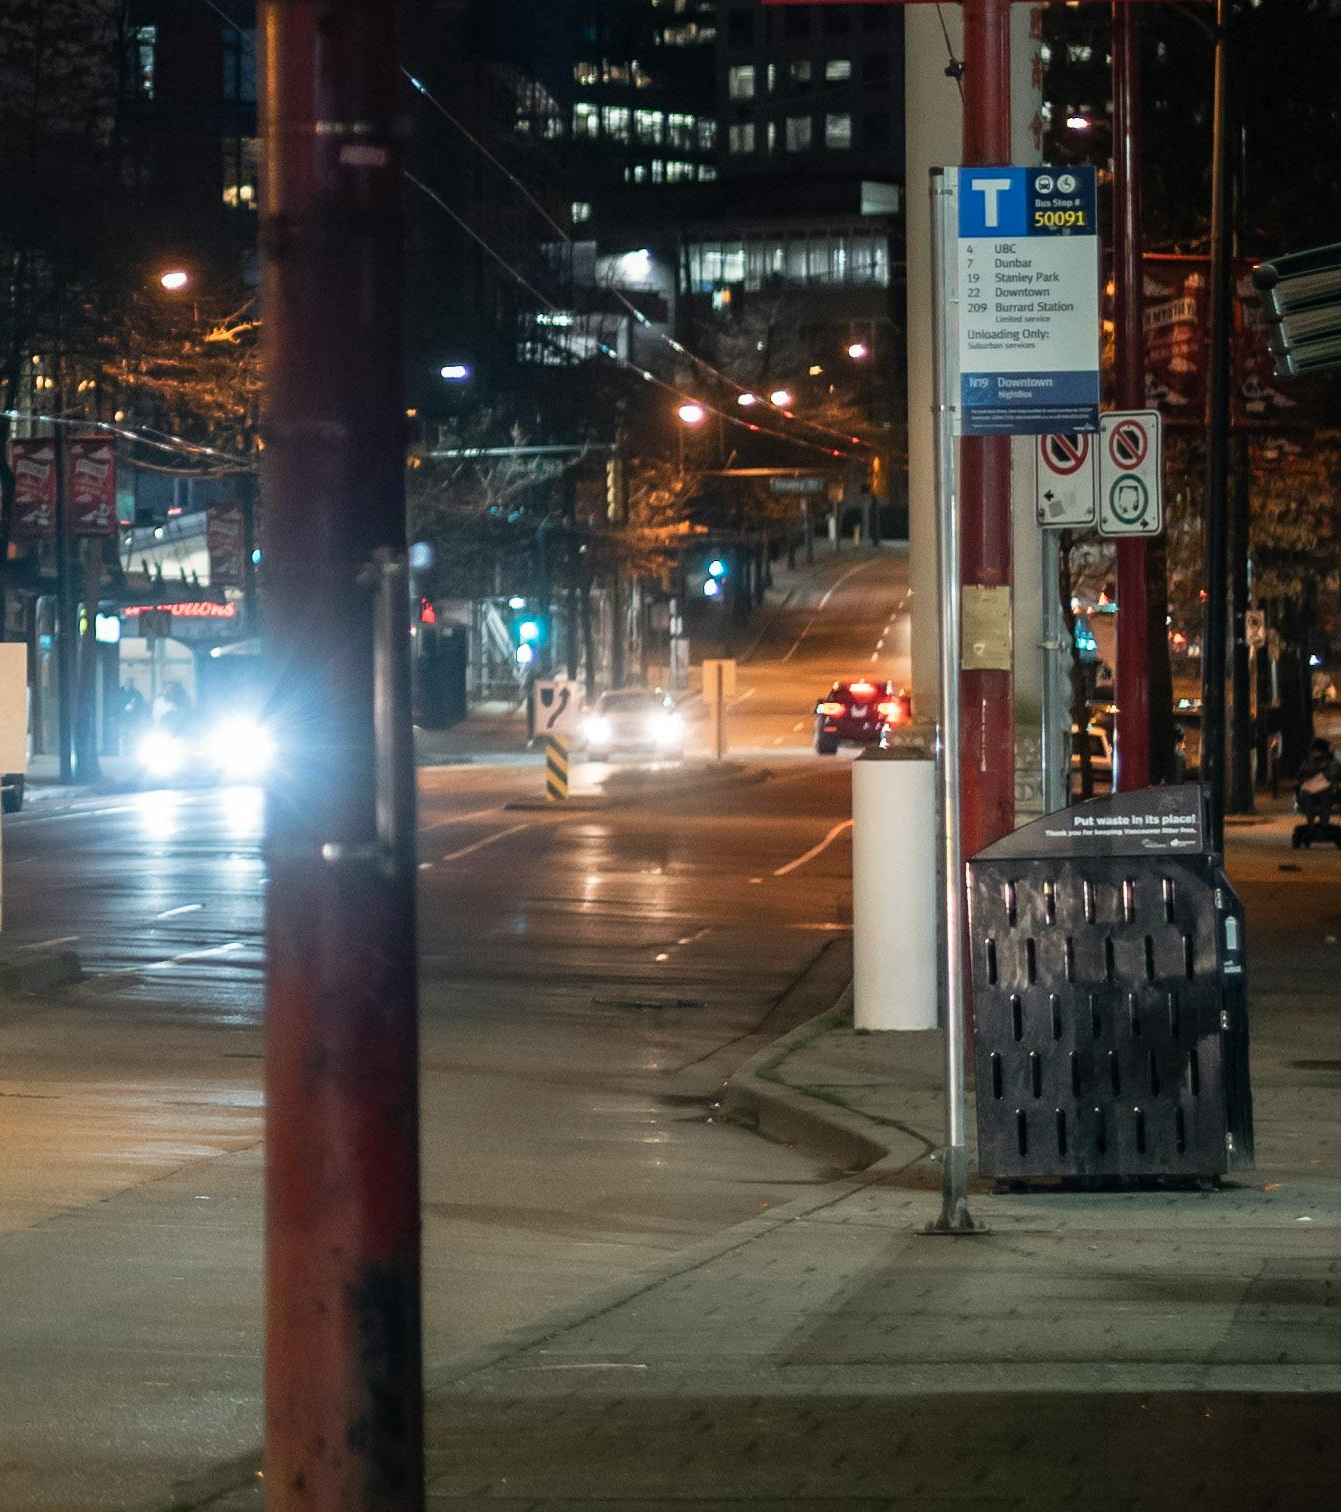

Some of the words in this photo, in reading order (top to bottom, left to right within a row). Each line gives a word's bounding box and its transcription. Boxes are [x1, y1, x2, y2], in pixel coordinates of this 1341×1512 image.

[971, 178, 1011, 228] T
[1035, 199, 1051, 208] Bus
[1053, 199, 1073, 208] Stop
[1034, 211, 1085, 227] 50091
[967, 244, 973, 254] 4
[994, 244, 1017, 254] UBC
[967, 258, 973, 268] 7
[994, 258, 1032, 268] Dunbar
[967, 273, 980, 283] 19
[995, 273, 1034, 285] Stanley
[1036, 272, 1060, 282] Park
[967, 288, 980, 298] 22
[995, 287, 1050, 297] Downtown
[967, 303, 988, 313] 209
[995, 302, 1034, 312] Burrard
[1037, 301, 1074, 312] Station
[995, 315, 1023, 323] Limited
[967, 329, 1020, 341] Unloading
[1022, 329, 1050, 340] Only:
[967, 342, 1003, 350] Suburban
[1005, 342, 1036, 350] services
[969, 377, 989, 388] N19
[997, 376, 1053, 387] Downtown
[1074, 816, 1094, 826] Put
[1097, 815, 1130, 825] waste
[1132, 814, 1143, 825] in
[1145, 814, 1159, 824] its
[1161, 813, 1196, 826] place!
[1045, 829, 1067, 837] Thank
[1094, 828, 1123, 836] keeping
